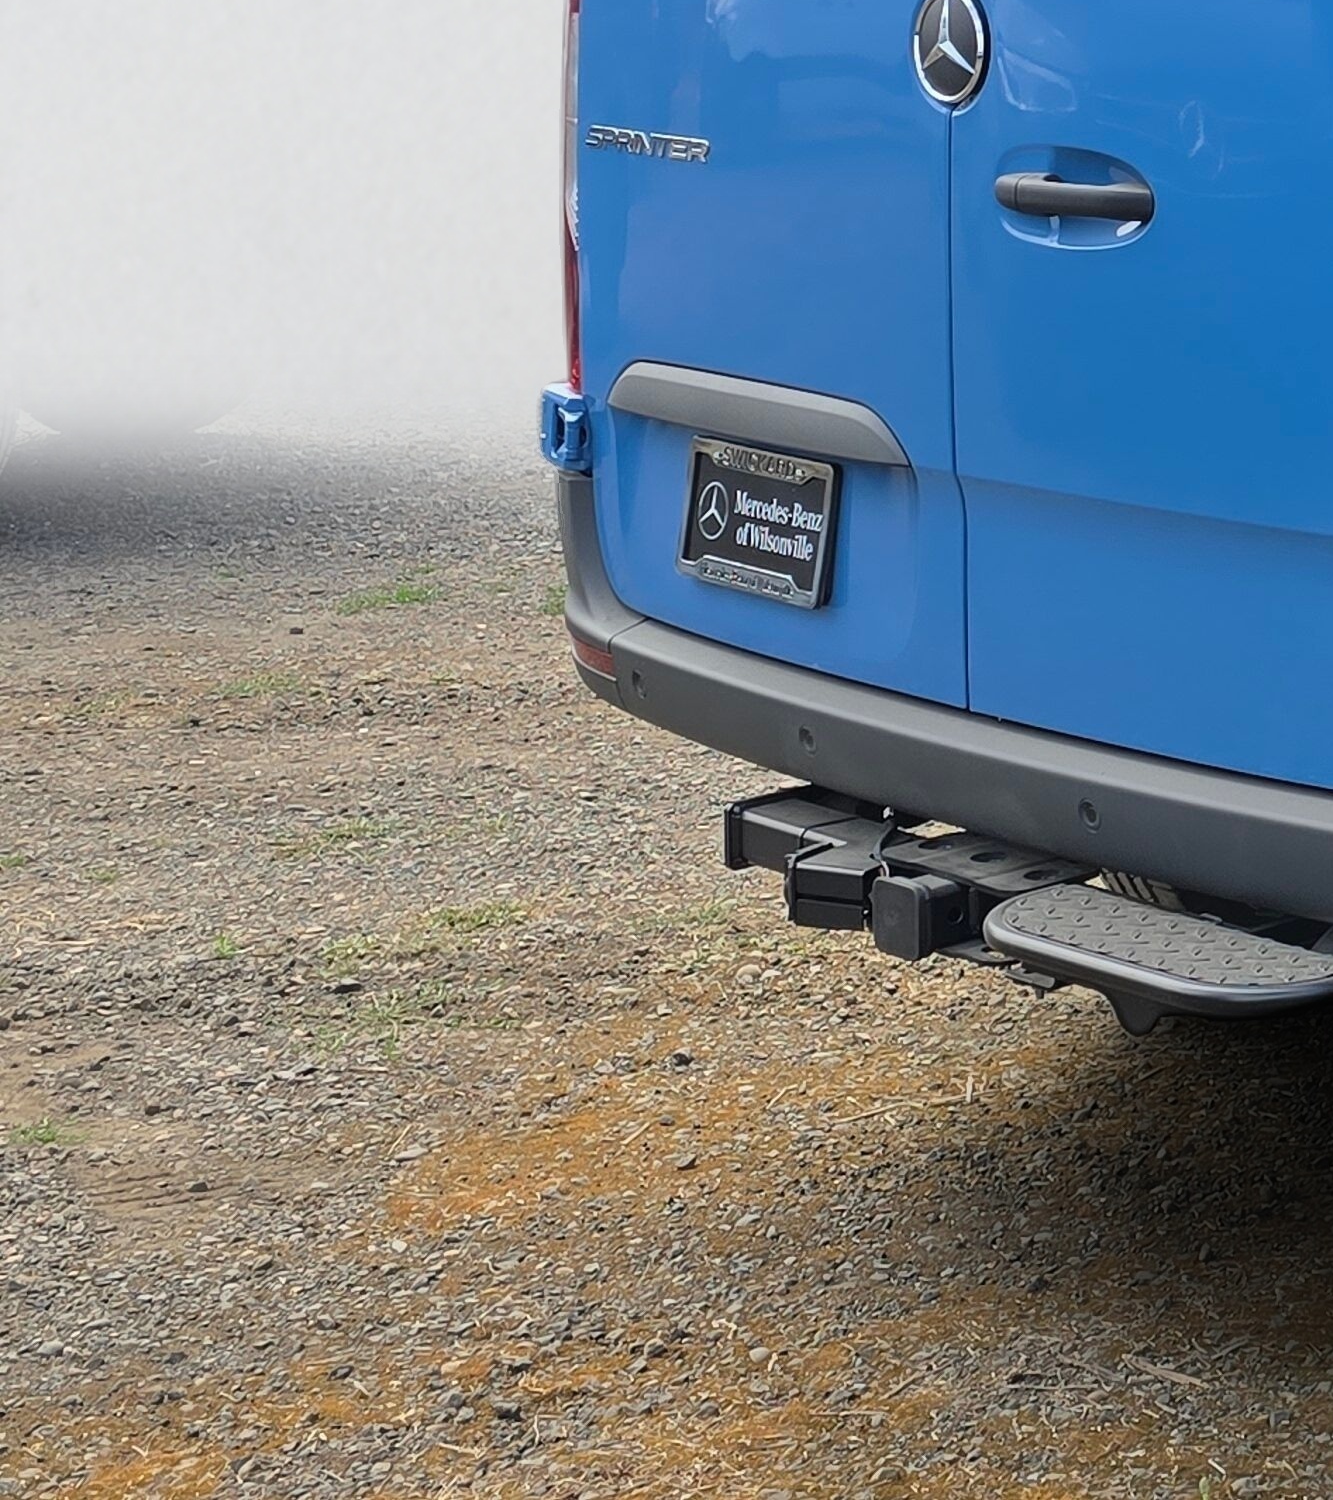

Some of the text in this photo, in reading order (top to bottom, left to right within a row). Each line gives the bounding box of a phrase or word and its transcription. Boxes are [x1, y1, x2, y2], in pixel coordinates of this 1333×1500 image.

[584, 124, 711, 164] SPRINTER
[734, 490, 824, 532] Mercedes-Benz
[736, 522, 814, 562] of Wilsonville
